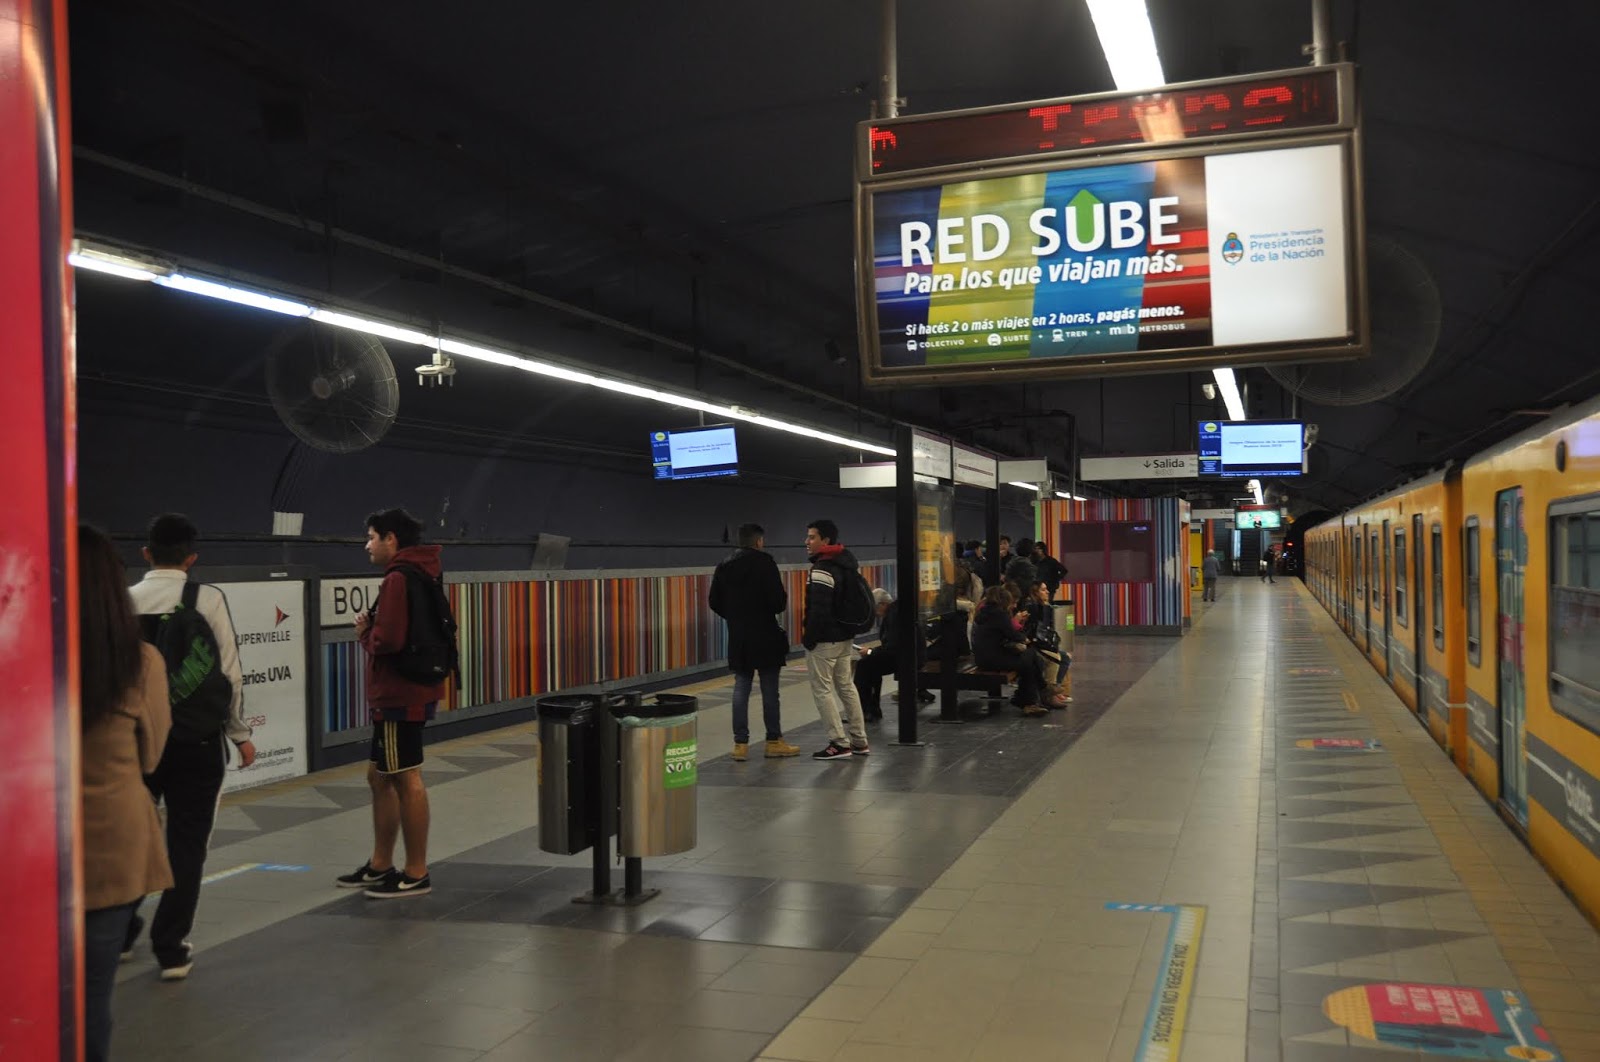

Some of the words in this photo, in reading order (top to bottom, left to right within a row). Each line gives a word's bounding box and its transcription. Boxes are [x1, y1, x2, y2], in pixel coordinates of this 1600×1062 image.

[900, 213, 1011, 268] RED
[1028, 196, 1181, 258] SUBE
[1250, 235, 1324, 250] Presidencia
[1250, 253, 1266, 263] de
[1269, 251, 1279, 262] la
[1282, 247, 1325, 260] Nación
[903, 271, 957, 295] Para
[959, 266, 993, 290] los
[997, 264, 1043, 290] que
[1048, 255, 1120, 285] viajan
[1125, 249, 1184, 276] más.
[905, 324, 918, 337] Si
[918, 322, 950, 336] hacés
[951, 321, 959, 333] 2
[961, 324, 969, 333] o
[971, 319, 995, 332] más
[996, 316, 1030, 332] viajes
[1031, 317, 1047, 328] en
[1048, 313, 1057, 326] 2
[1058, 311, 1095, 327] horas,
[1096, 308, 1136, 324] pagás
[1137, 304, 1185, 319] menos.
[919, 339, 965, 349] COLECTIVO
[1002, 334, 1030, 343] SUBTE
[1065, 329, 1088, 339] TREN
[1138, 323, 1186, 333] METROBUS
[1153, 459, 1185, 469] Salida
[268, 665, 292, 682] UVA
